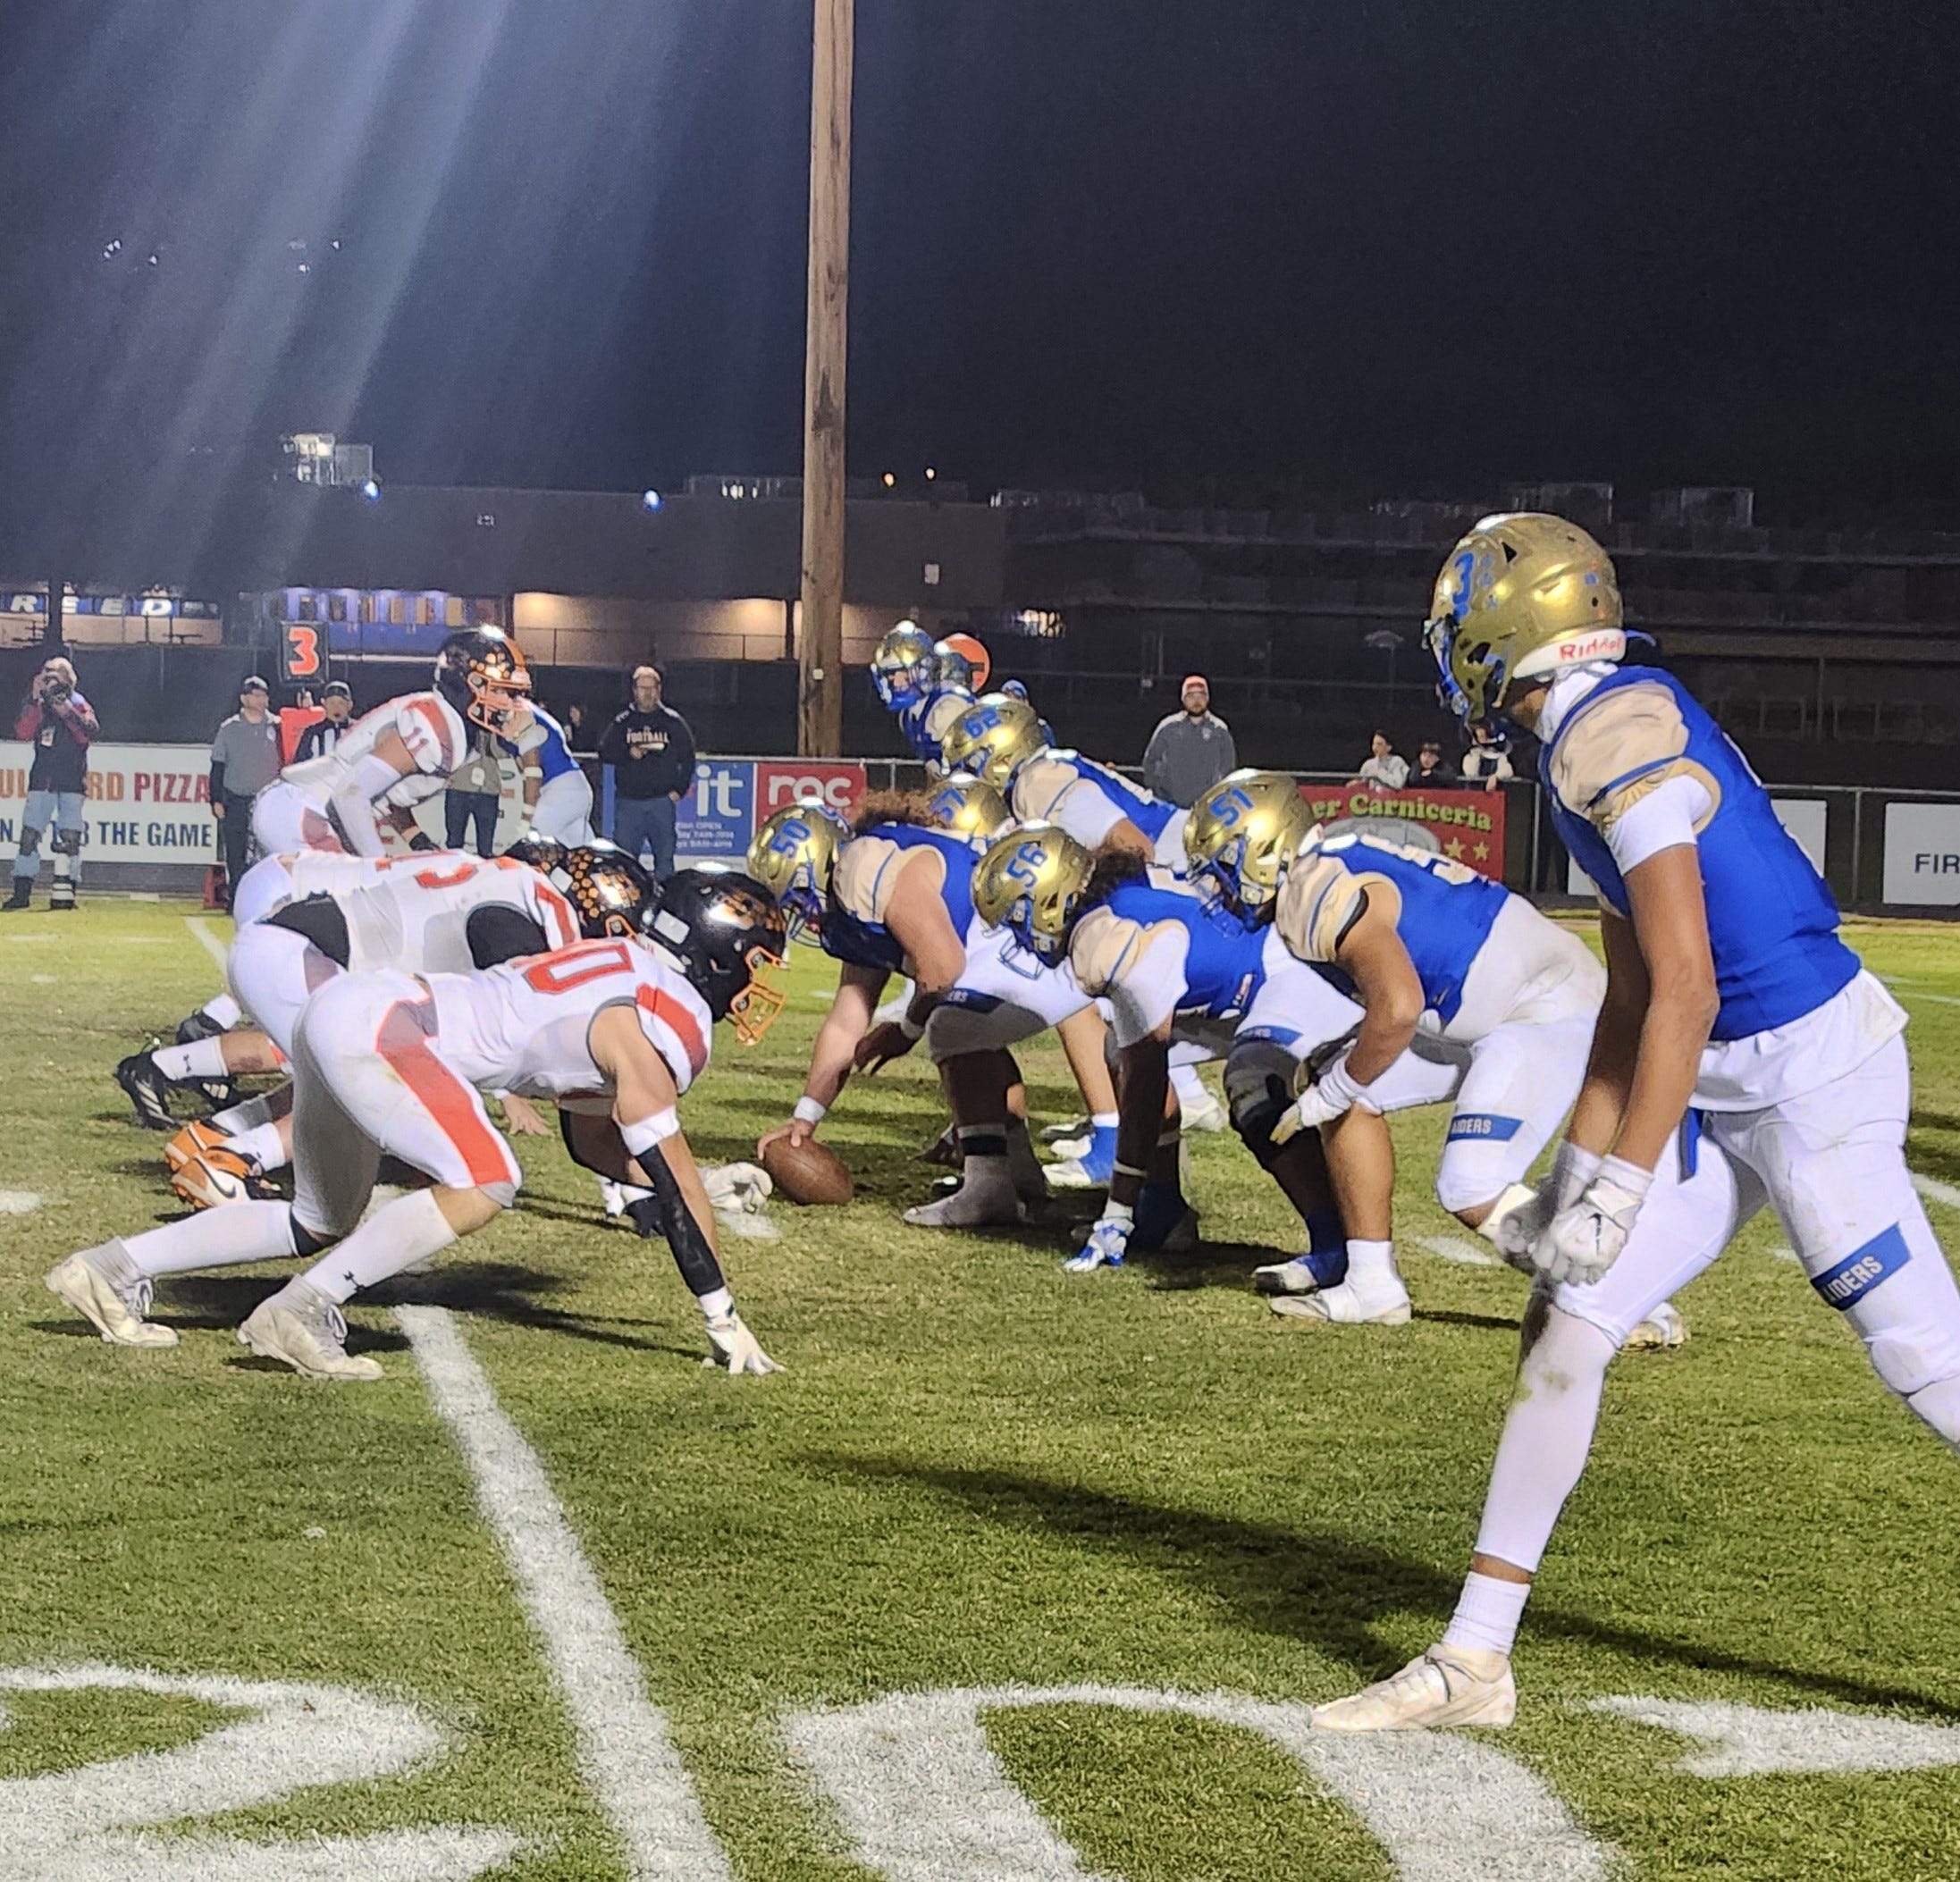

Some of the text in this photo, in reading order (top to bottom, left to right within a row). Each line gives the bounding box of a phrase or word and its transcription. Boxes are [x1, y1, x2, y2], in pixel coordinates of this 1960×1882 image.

[289, 626, 319, 675] 3
[134, 772, 212, 803] PIZZA
[769, 775, 852, 808] roc
[1210, 788, 1254, 828] 51
[1349, 794, 1493, 831] Carniceria
[97, 821, 139, 846] THE
[147, 822, 213, 847] GAME
[771, 819, 811, 859] 50
[1006, 841, 1047, 888] 56
